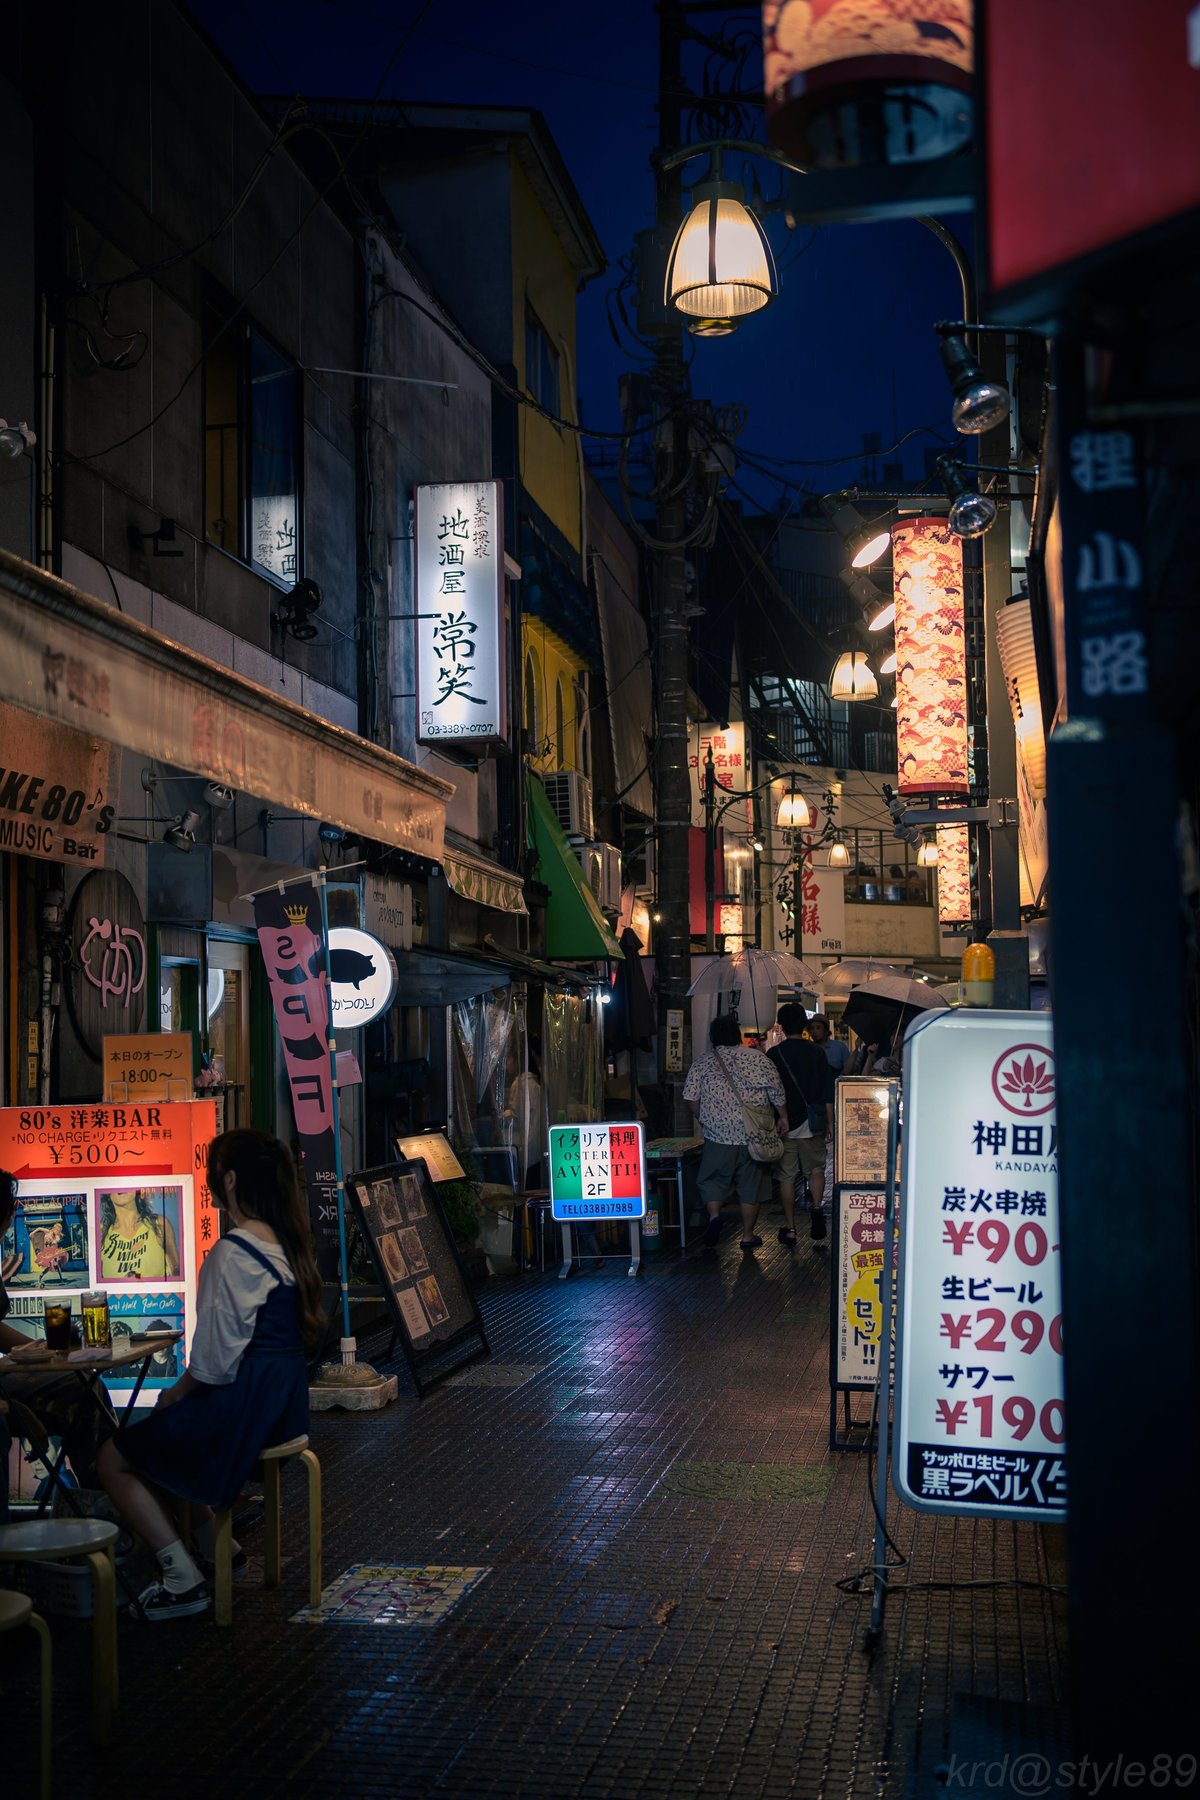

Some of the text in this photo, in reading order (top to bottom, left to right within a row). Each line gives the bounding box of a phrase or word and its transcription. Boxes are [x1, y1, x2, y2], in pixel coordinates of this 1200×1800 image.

[432, 508, 488, 706] 地酒屋 常笑
[700, 736, 727, 749] 三階
[701, 772, 733, 791] 室
[0, 818, 98, 860] MUSIC Bar
[111, 1049, 183, 1063] 本日のオープン
[20, 1107, 162, 1130] 80's 洋楽BAR
[17, 1133, 35, 1144] NO
[39, 1131, 91, 1143] CHARGE
[555, 1131, 635, 1148] イタリア料理
[972, 1120, 1058, 1156] 神田
[564, 1150, 625, 1161] OSTERIA
[556, 1163, 638, 1178] AVANTI!
[995, 1161, 1058, 1173] KANDAYA
[587, 1183, 607, 1195] 2F
[562, 1202, 633, 1214] TEL(3388)7989
[941, 1186, 1047, 1217] 炭火串焼
[117, 1258, 142, 1273] Wet
[941, 1275, 1043, 1304] 生ビール
[9, 1299, 43, 1314] STING
[938, 1363, 1015, 1390] サワー
[935, 1394, 1067, 1445] ¥190
[922, 1450, 1030, 1473] サッポロ生ビール
